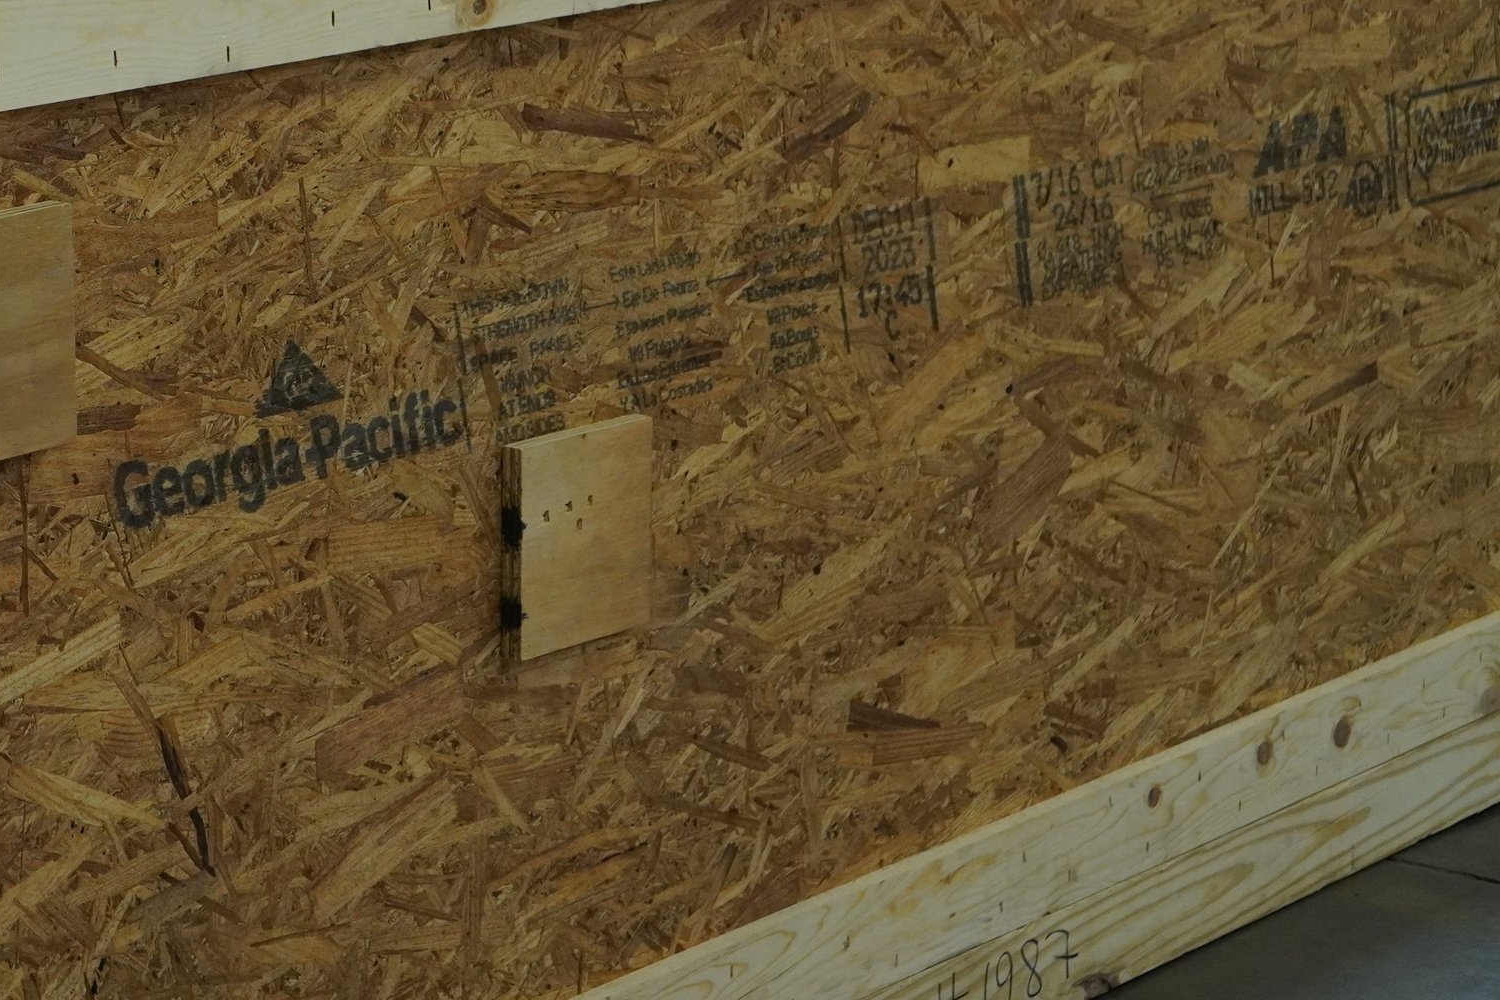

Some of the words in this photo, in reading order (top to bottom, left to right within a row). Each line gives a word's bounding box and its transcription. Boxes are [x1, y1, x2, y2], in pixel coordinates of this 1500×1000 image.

[1252, 105, 1349, 178] APA
[1029, 164, 1081, 211] 7/16
[1091, 152, 1126, 189] CAT
[1052, 192, 1116, 232] 24/16
[862, 235, 917, 276] 2023
[856, 274, 923, 319] 17:45
[885, 310, 902, 341] C
